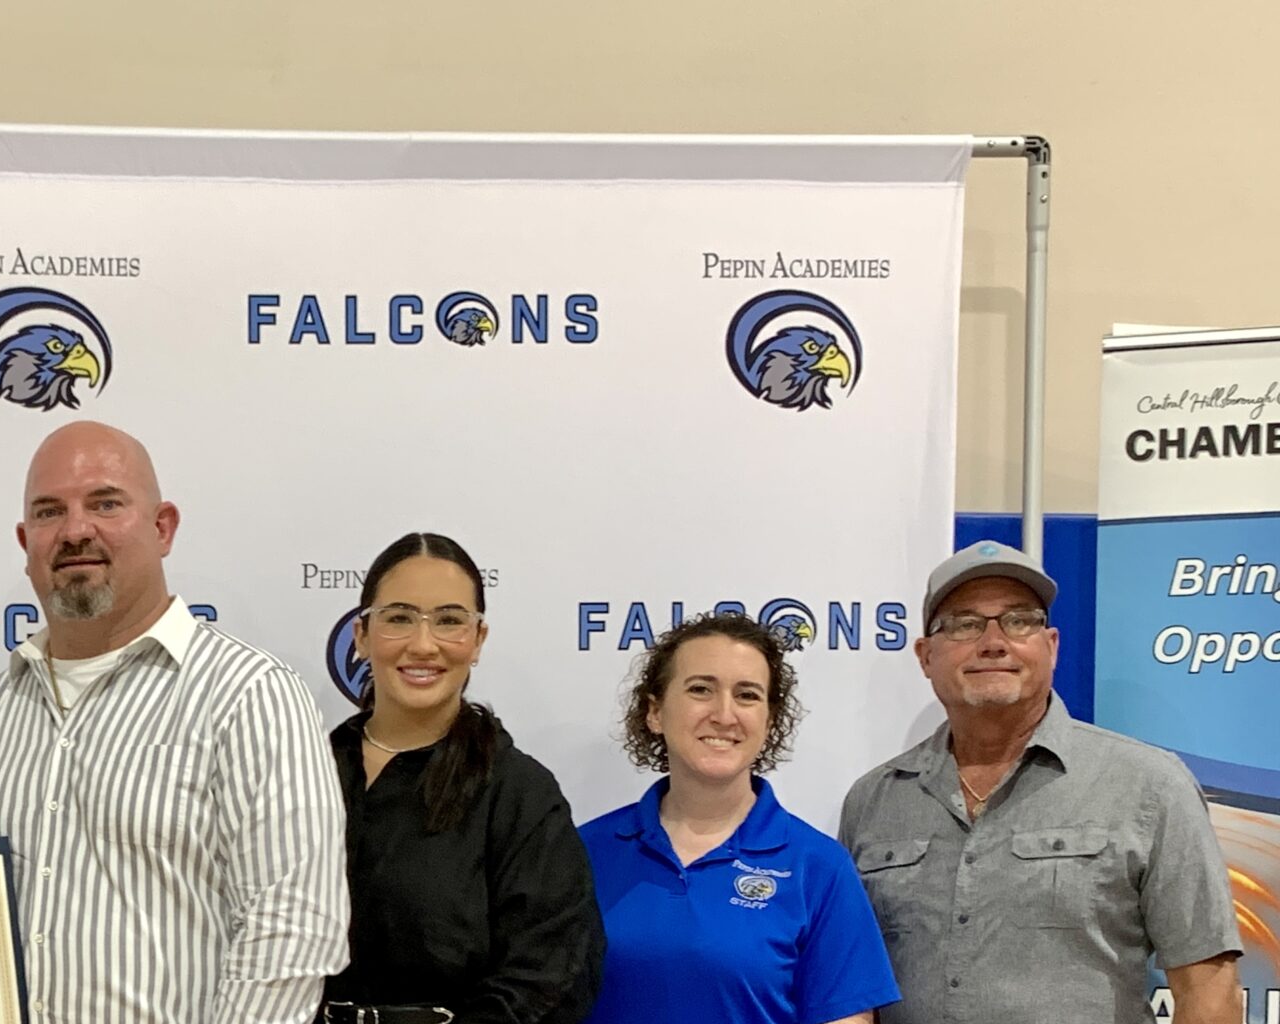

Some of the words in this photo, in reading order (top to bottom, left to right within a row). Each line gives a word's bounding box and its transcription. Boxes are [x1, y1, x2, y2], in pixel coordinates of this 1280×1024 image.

[9, 247, 140, 278] ACADEMIES
[702, 252, 765, 278] PEPIN
[769, 251, 890, 279] ACADEMIES
[247, 291, 599, 348] FALCONS
[1137, 388, 1190, 414] Central
[1189, 381, 1278, 420] Hillsborough
[1168, 553, 1280, 604] Brin
[578, 597, 908, 652] FAONS
